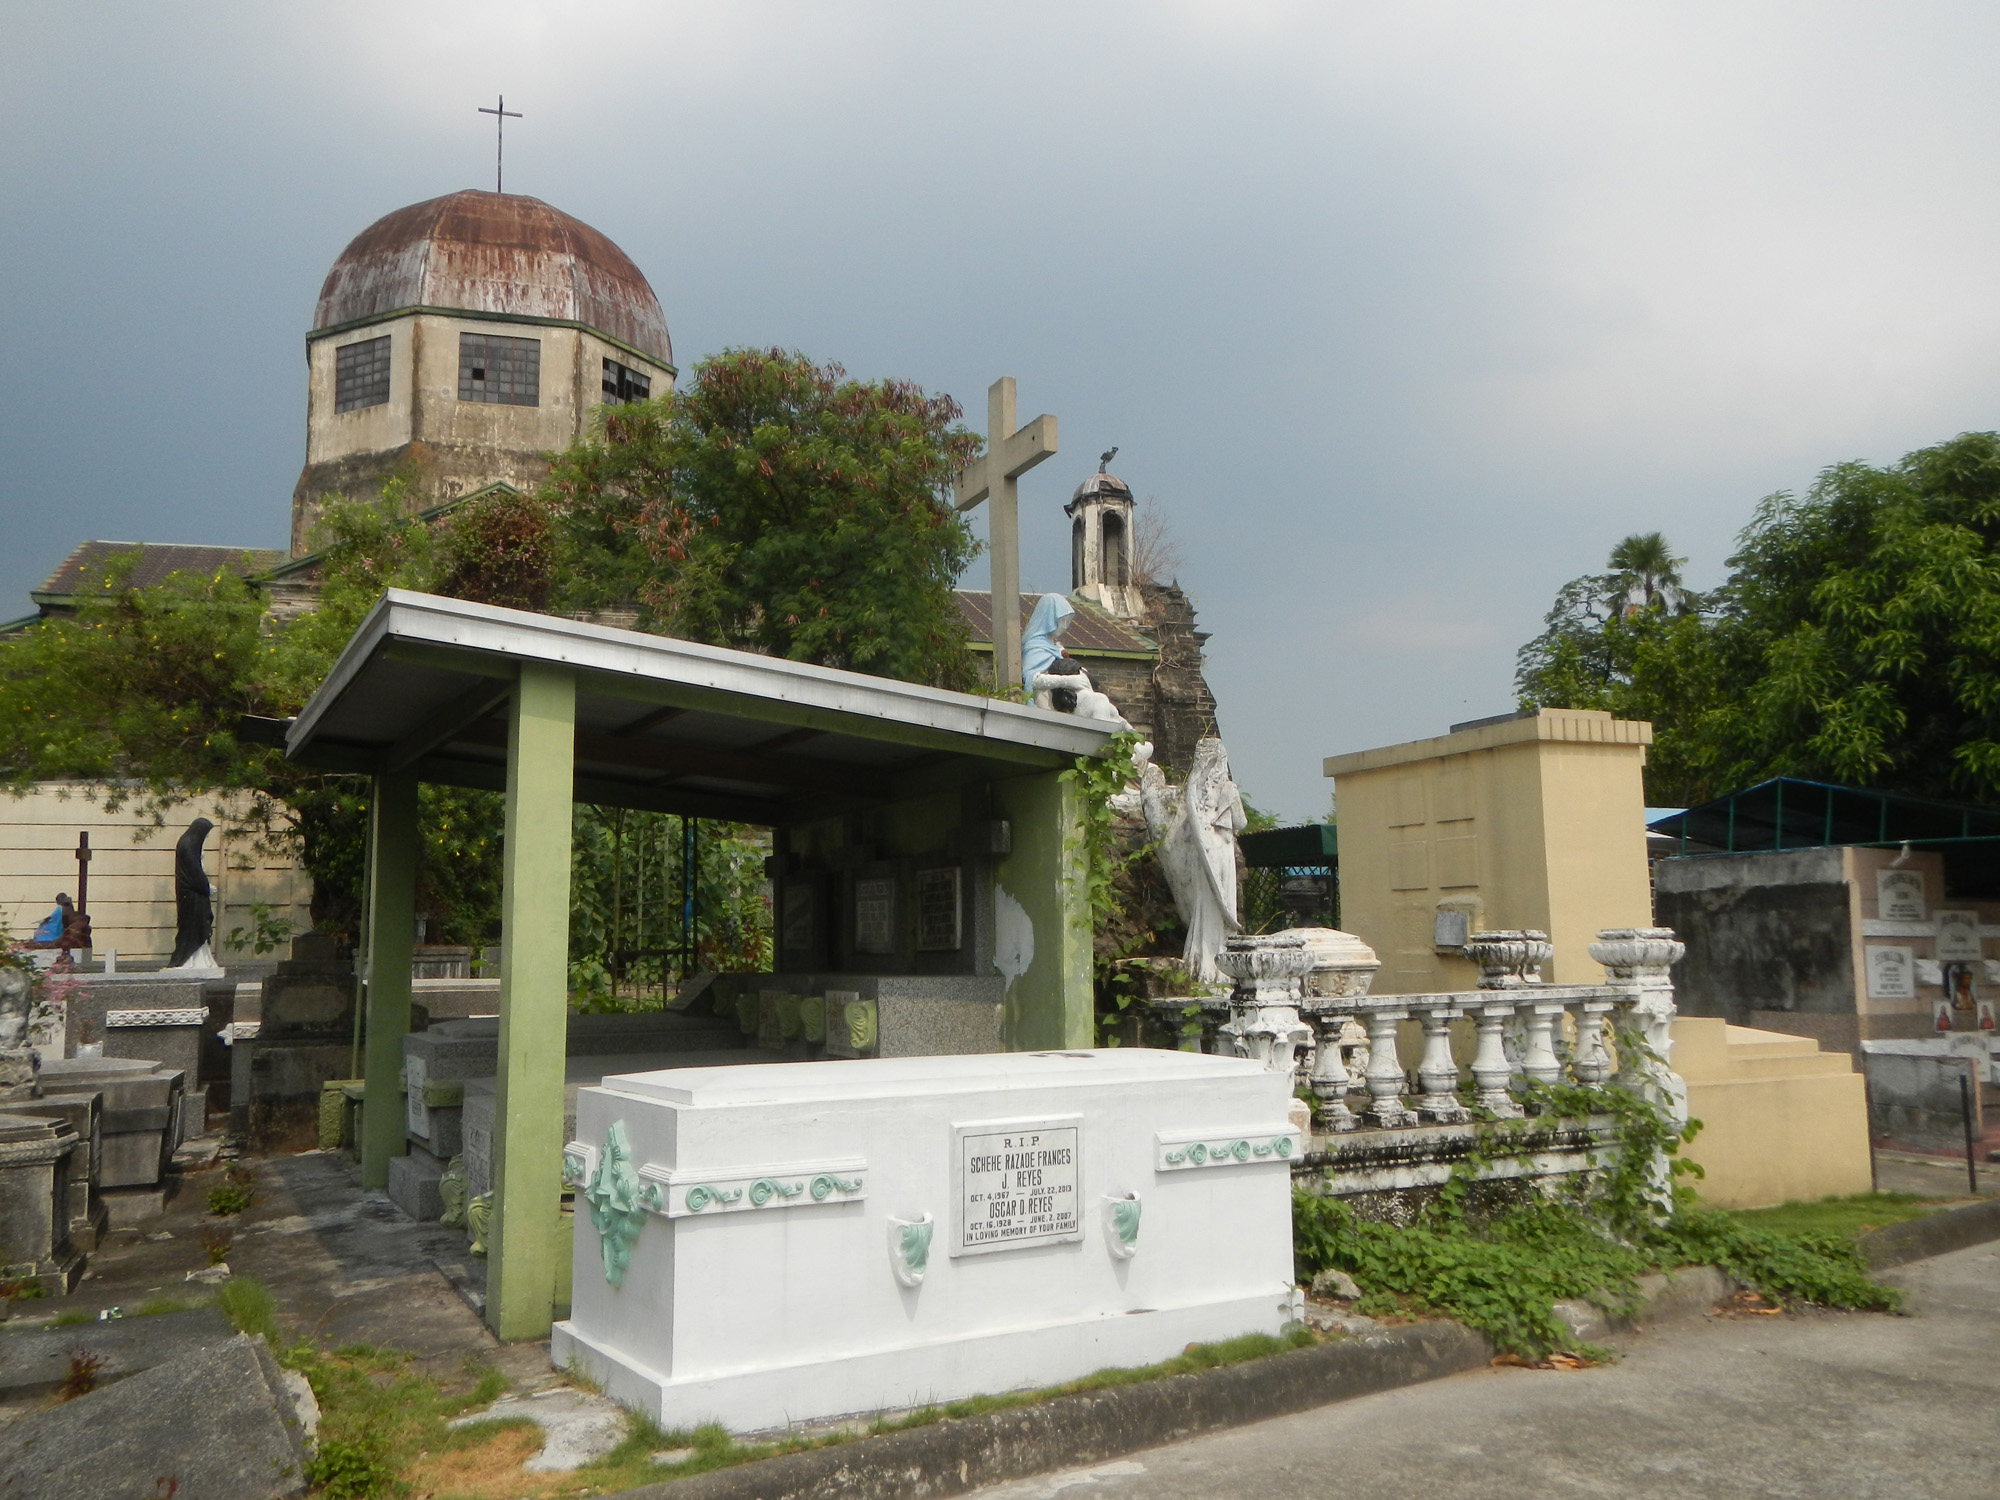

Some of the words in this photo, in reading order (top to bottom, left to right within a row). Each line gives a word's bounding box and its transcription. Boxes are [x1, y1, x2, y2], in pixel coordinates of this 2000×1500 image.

[1004, 1136, 1040, 1148] R.I.P.
[970, 1155, 1002, 1174] SCHEHE
[1038, 1148, 1071, 1167] FRANCES
[1002, 1173, 1010, 1190] J.
[1016, 1169, 1042, 1188] REYES
[970, 1194, 986, 1202] OCT.
[989, 1200, 1016, 1218] OSCAR
[1028, 1196, 1053, 1214] REYES
[966, 1232, 974, 1242] IN
[975, 1230, 999, 1240] LOVING
[1000, 1226, 1027, 1237] MEMORY
[1030, 1226, 1036, 1234] OF
[1039, 1223, 1054, 1232] YOUR
[1056, 1220, 1076, 1230] FAMILY
[970, 1222, 984, 1230] OCT.
